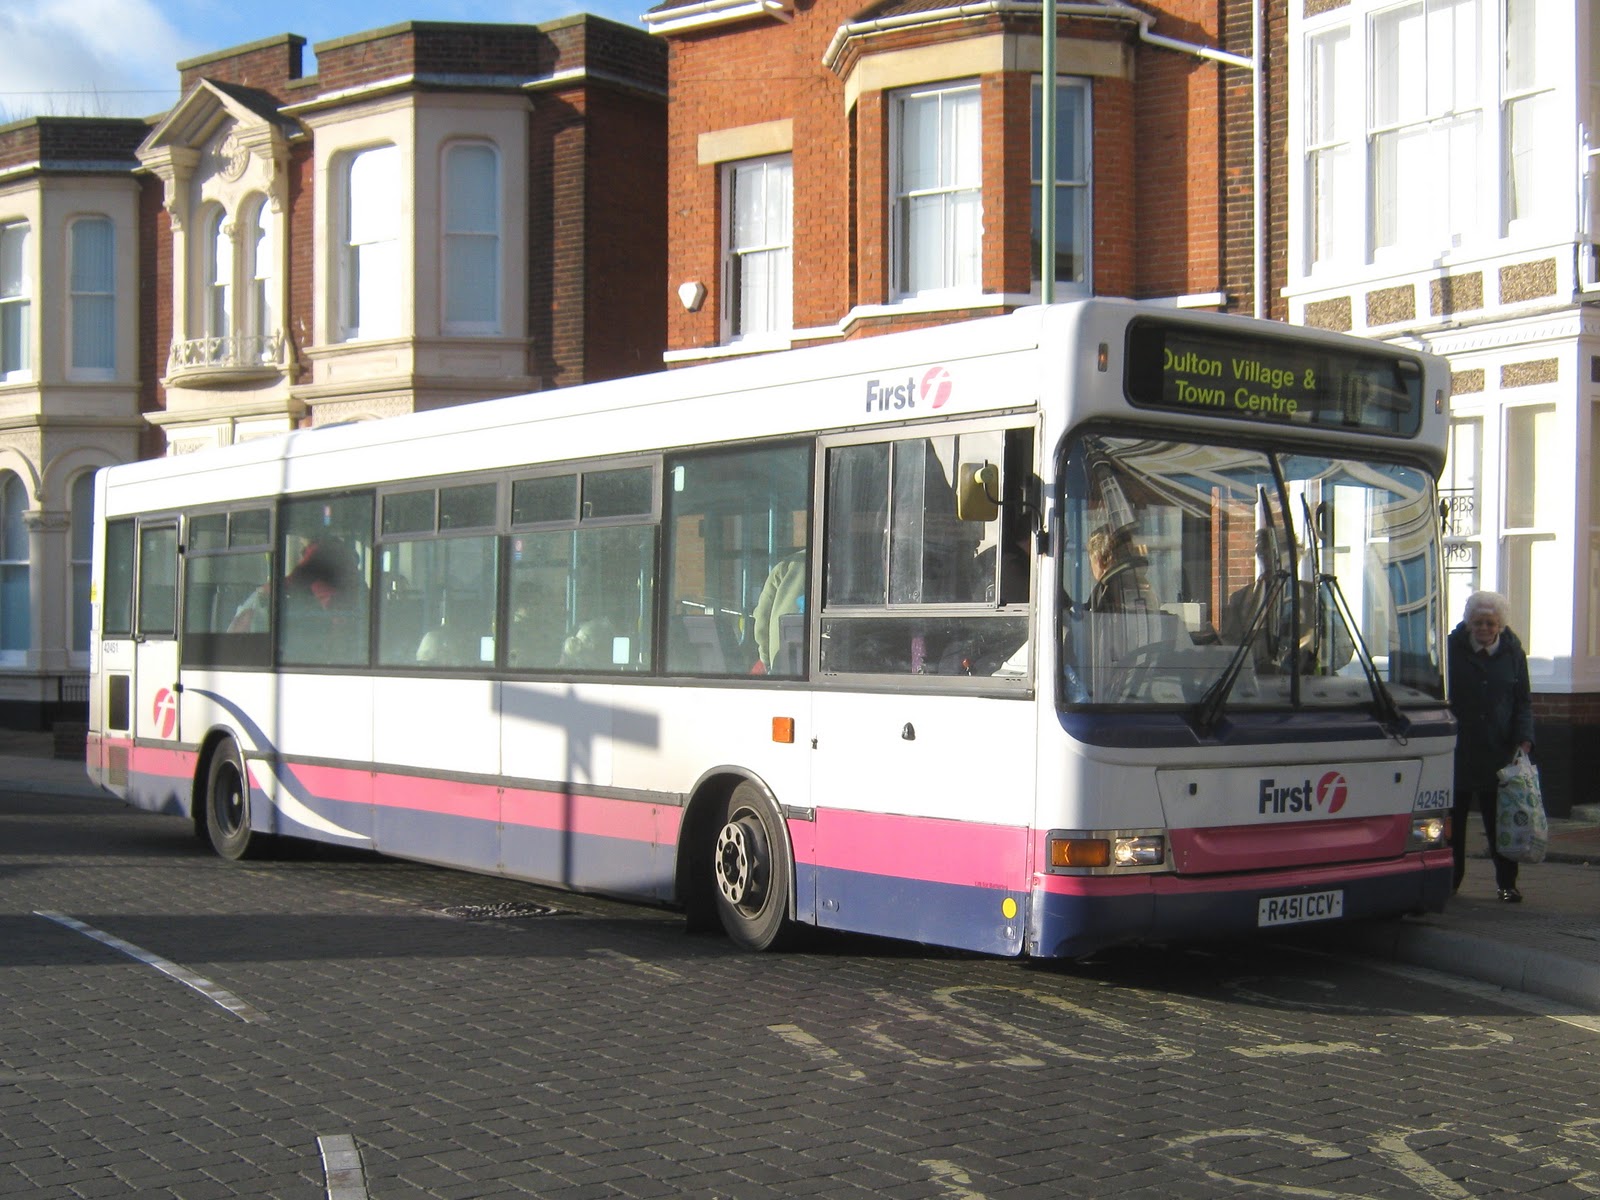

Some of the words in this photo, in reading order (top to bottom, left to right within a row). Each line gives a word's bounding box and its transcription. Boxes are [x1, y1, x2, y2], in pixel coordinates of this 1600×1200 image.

[1231, 357, 1295, 389] Village
[1303, 367, 1316, 390] &
[866, 377, 916, 413] First
[1175, 379, 1225, 407] Town
[1234, 387, 1298, 415] Centre
[1258, 778, 1312, 814] First
[1417, 790, 1450, 809] 42451
[1268, 897, 1303, 922] R451
[1306, 893, 1335, 917] CCV
